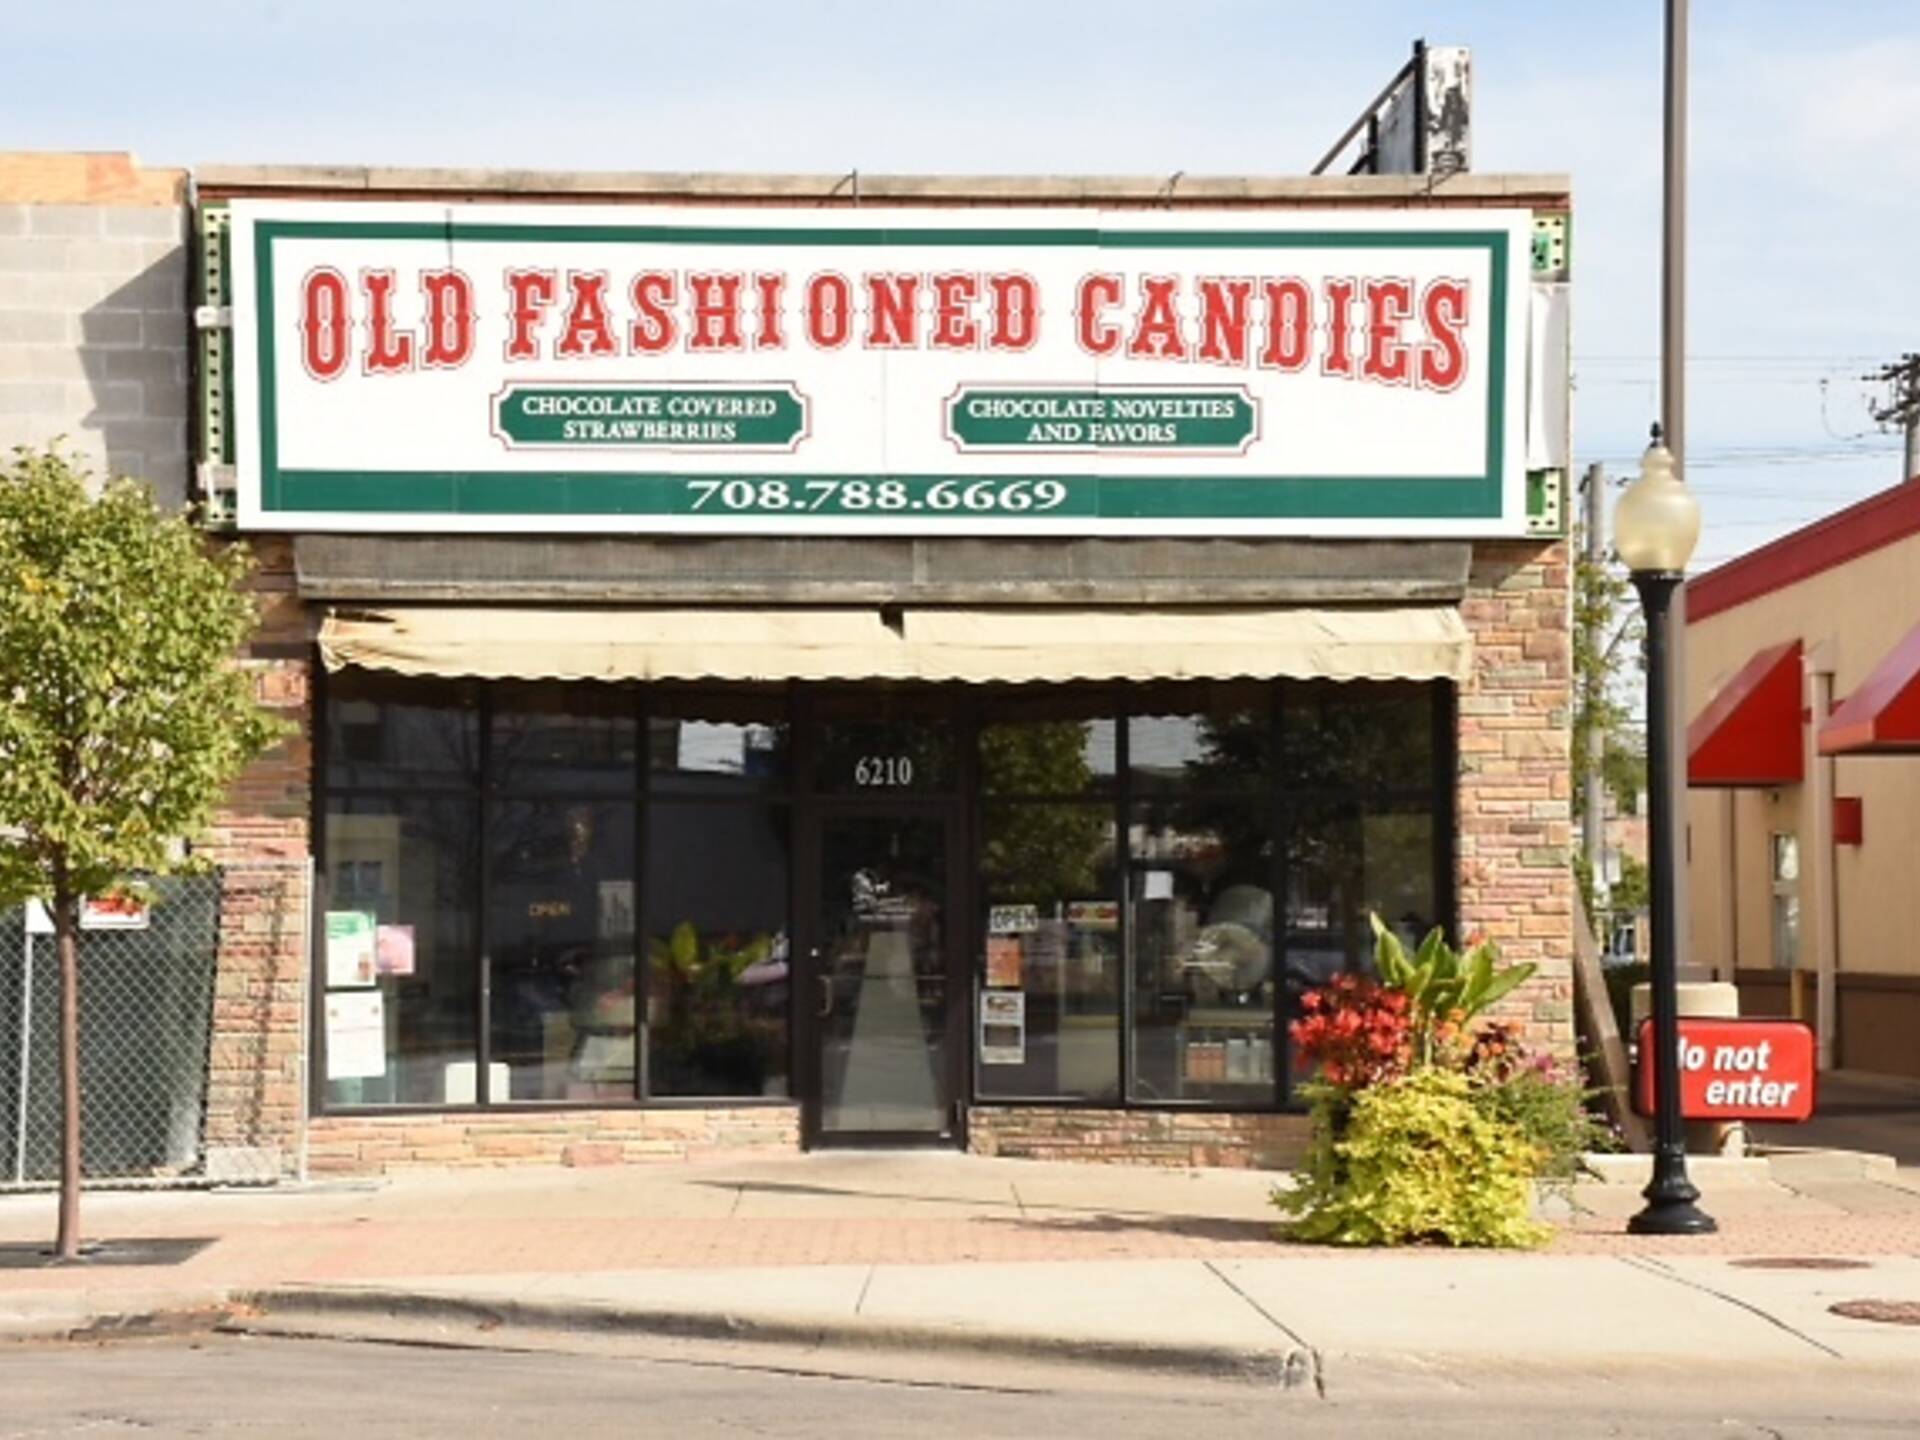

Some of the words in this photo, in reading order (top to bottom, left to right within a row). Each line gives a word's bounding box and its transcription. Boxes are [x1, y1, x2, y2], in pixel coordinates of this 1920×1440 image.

[299, 266, 477, 382] OLD
[504, 267, 1042, 360] FASHIONED
[1073, 273, 1470, 393] CANDIES
[521, 396, 661, 416] CHOCOLATE
[667, 397, 777, 417] COVERED
[968, 398, 1106, 418] CHOCOLATE
[1112, 399, 1236, 418] NOVELTIES
[562, 420, 737, 440] STRAWBERRIES
[1027, 423, 1082, 442] AND
[1088, 423, 1177, 442] FAVORS
[686, 479, 1067, 511] 708.788.6669
[855, 756, 913, 785] 6210
[993, 908, 1037, 930] OPEN
[1713, 1040, 1771, 1071] not
[1706, 1075, 1797, 1107] enter
